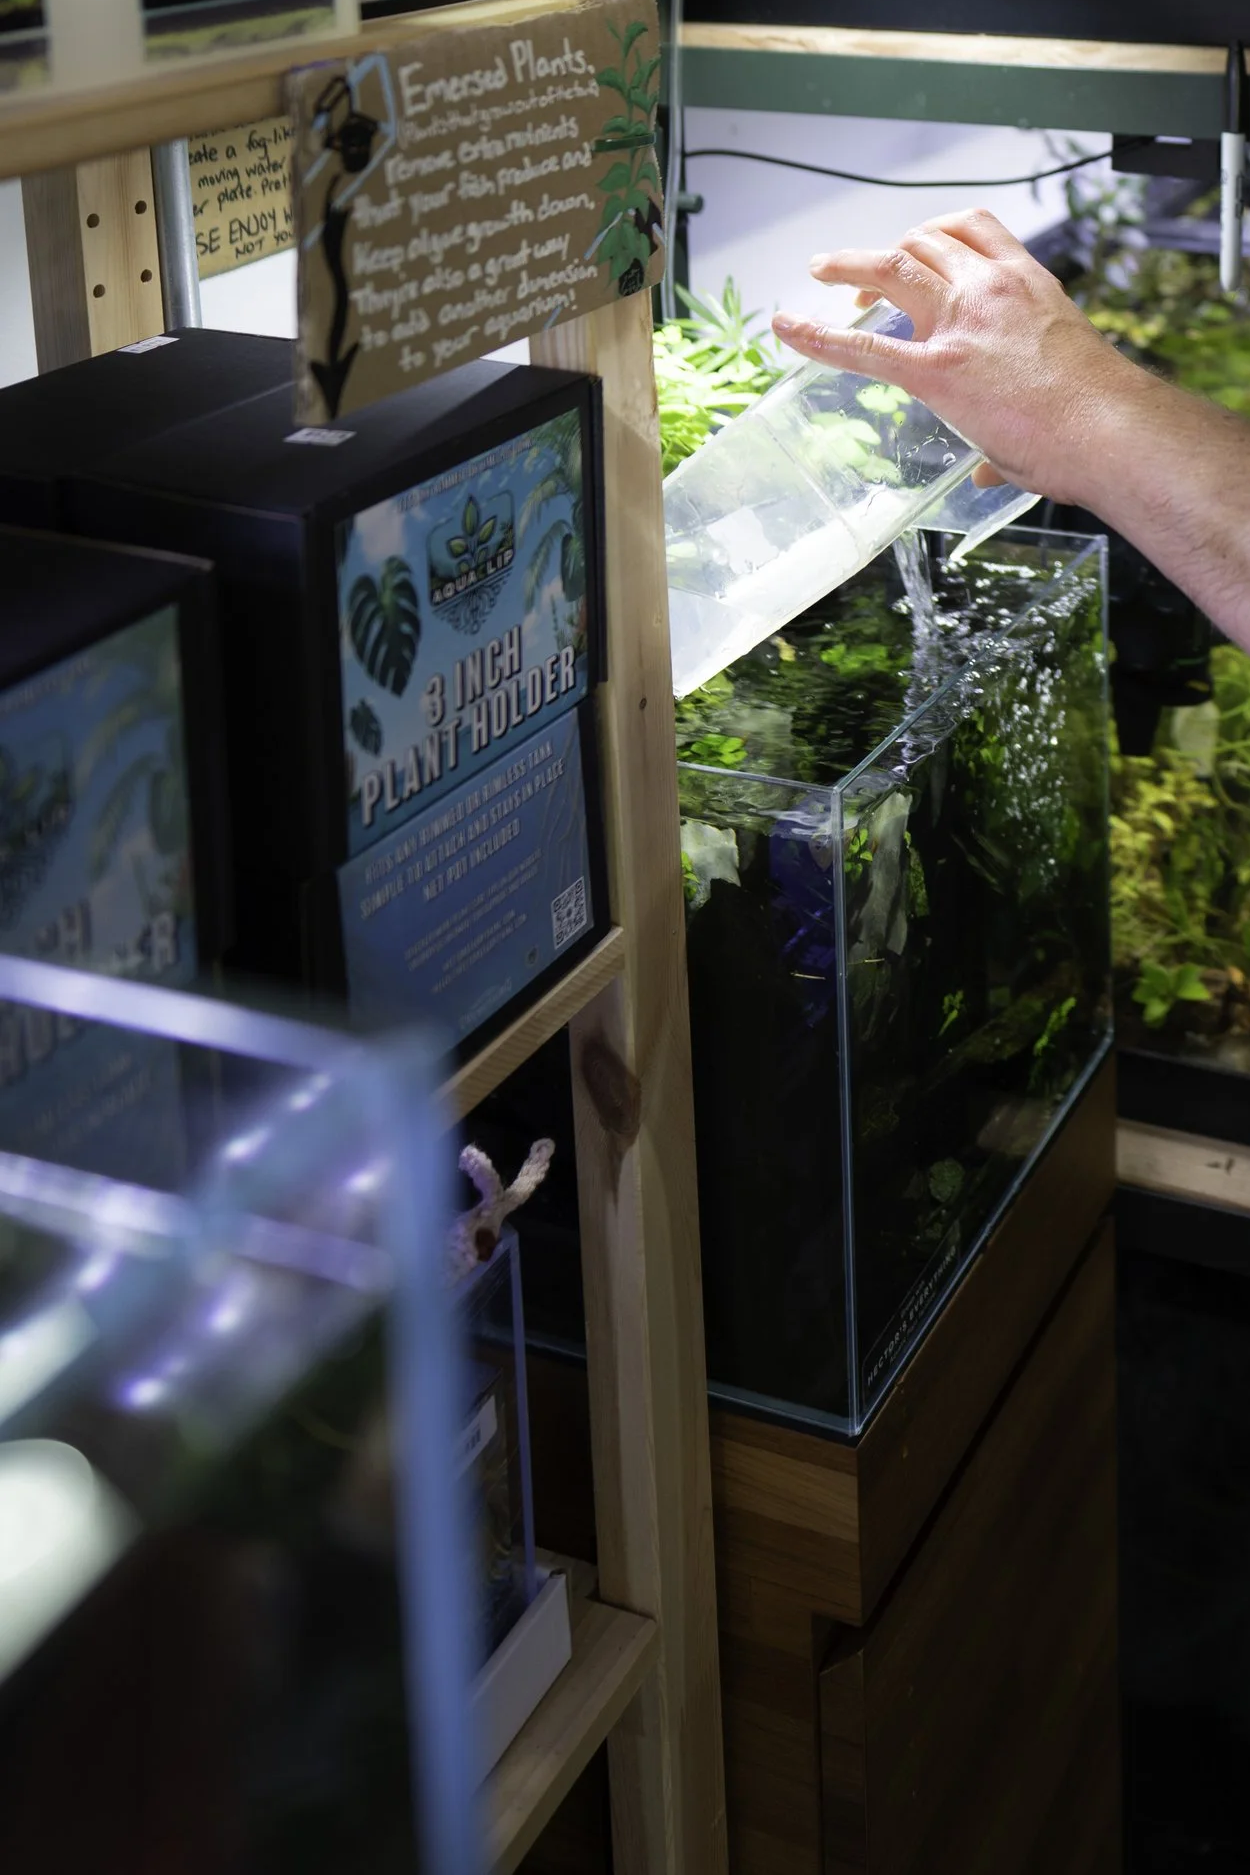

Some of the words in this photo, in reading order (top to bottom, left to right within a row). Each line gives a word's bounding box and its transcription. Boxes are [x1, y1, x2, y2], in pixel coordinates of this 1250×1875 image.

[399, 57, 508, 116] Emersed
[509, 38, 595, 83] Plants.
[198, 167, 241, 190] moving
[245, 156, 286, 177] water
[225, 145, 237, 159] a
[458, 171, 495, 199] fish
[496, 157, 560, 195] produce
[562, 142, 592, 169] and
[229, 206, 276, 245] ENJOY
[235, 237, 265, 259] NOT
[421, 266, 465, 295] also
[467, 263, 483, 282] a
[485, 239, 532, 286] great
[533, 233, 571, 261] way
[465, 199, 535, 254] growth
[358, 325, 389, 351] to
[391, 308, 431, 342] add
[437, 286, 512, 324] another
[516, 258, 598, 300] dimension
[399, 345, 426, 372] to
[432, 325, 480, 368] your
[484, 289, 578, 341] aquarium!
[426, 672, 445, 727] 3
[453, 625, 521, 712] INCH
[361, 716, 462, 829] PLANT
[471, 644, 576, 754] HOLDER
[418, 805, 465, 845] RIMMED
[481, 759, 527, 802] RIMLESS
[527, 741, 553, 772] TANK
[360, 877, 405, 919] SIMPLE
[424, 830, 466, 874] ATTACH
[467, 815, 489, 841] AND
[489, 792, 521, 825] STAYS
[521, 781, 533, 803] IN
[534, 757, 566, 794] PLACE
[422, 876, 446, 903] NET
[446, 859, 468, 886] POT
[469, 817, 520, 870] INCLUDED
